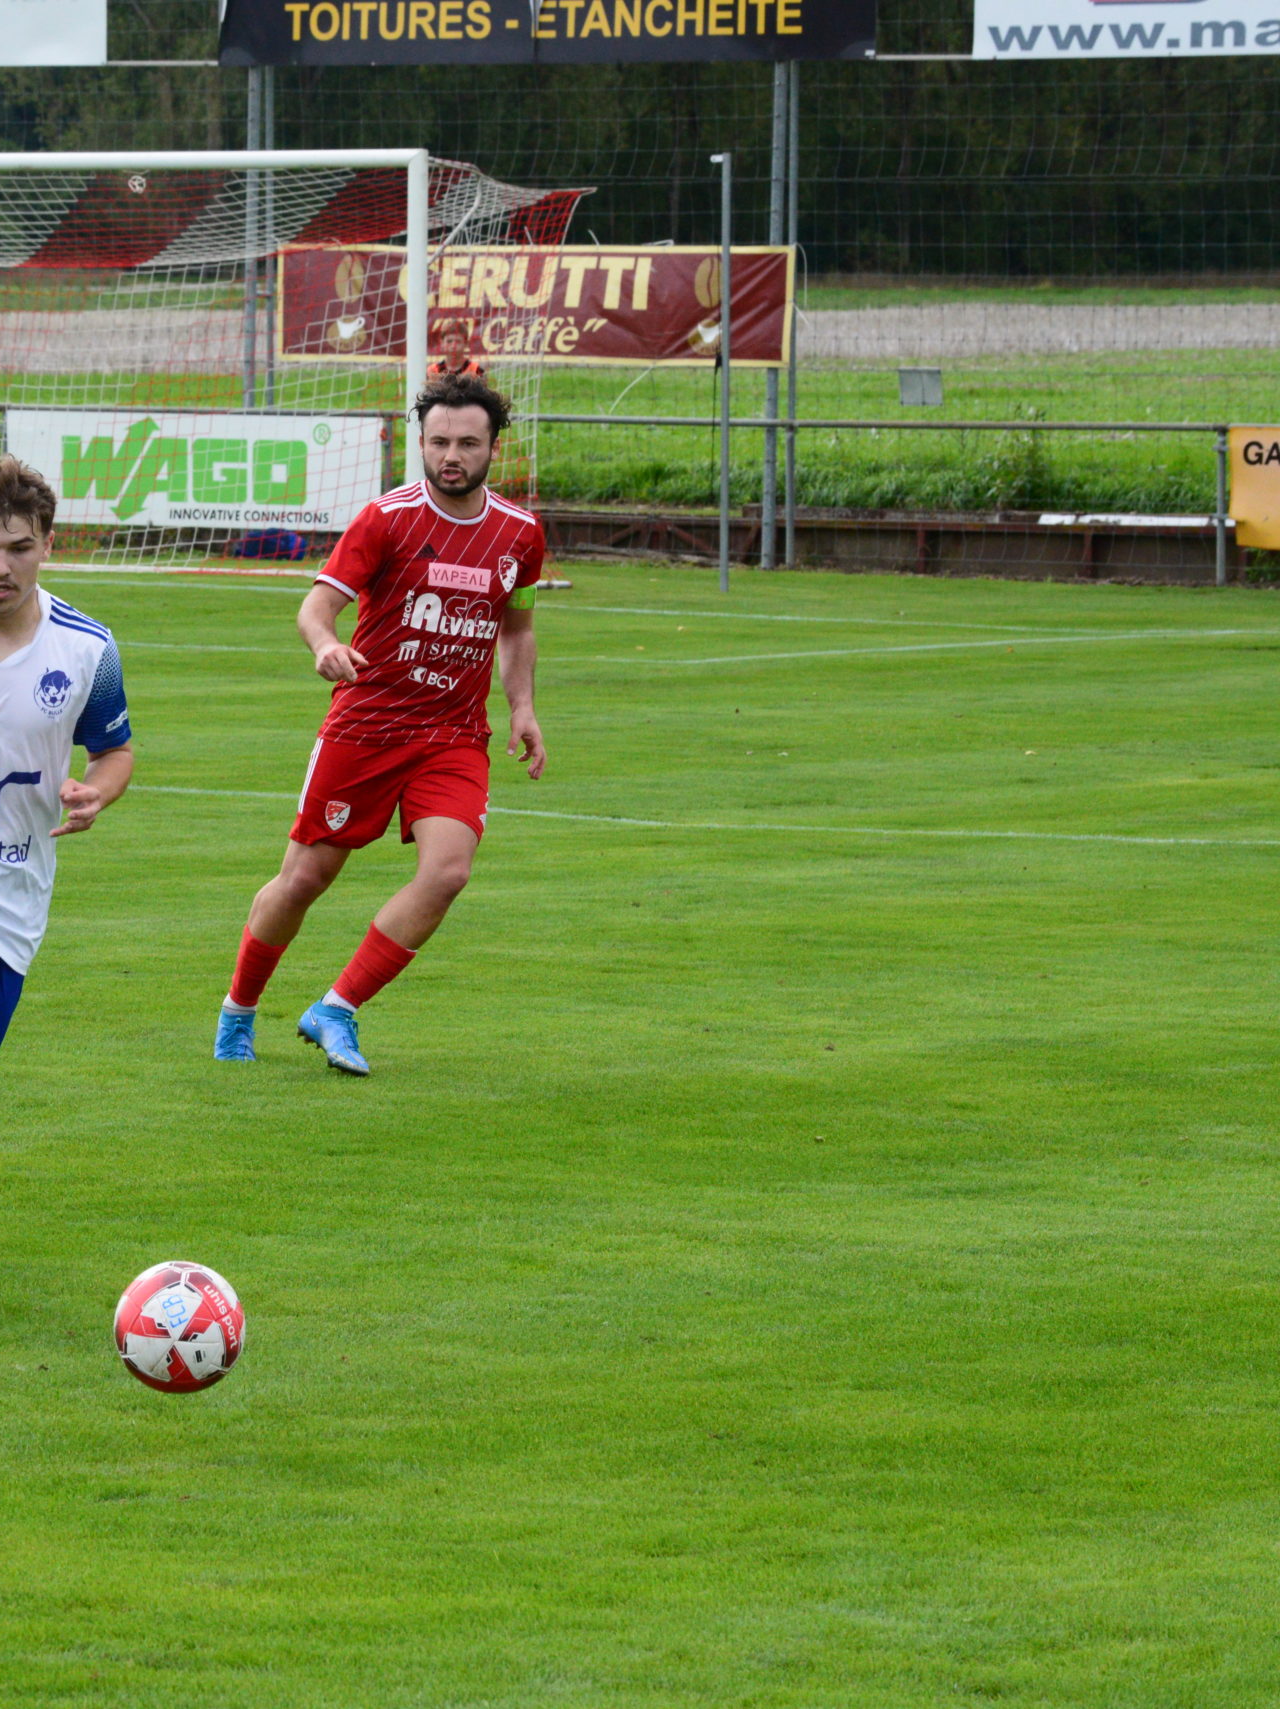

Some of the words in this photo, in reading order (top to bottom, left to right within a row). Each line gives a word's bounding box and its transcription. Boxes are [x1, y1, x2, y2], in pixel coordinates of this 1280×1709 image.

[284, 1, 492, 41] TOITURES
[1243, 440, 1280, 466] GA
[61, 418, 308, 519] WAGO
[169, 508, 241, 523] INNOVATIVE
[243, 509, 330, 525] CONNECTIONS
[432, 567, 487, 587] YAPEAL
[427, 671, 460, 691] BCV
[203, 1284, 239, 1349] uhlsport
